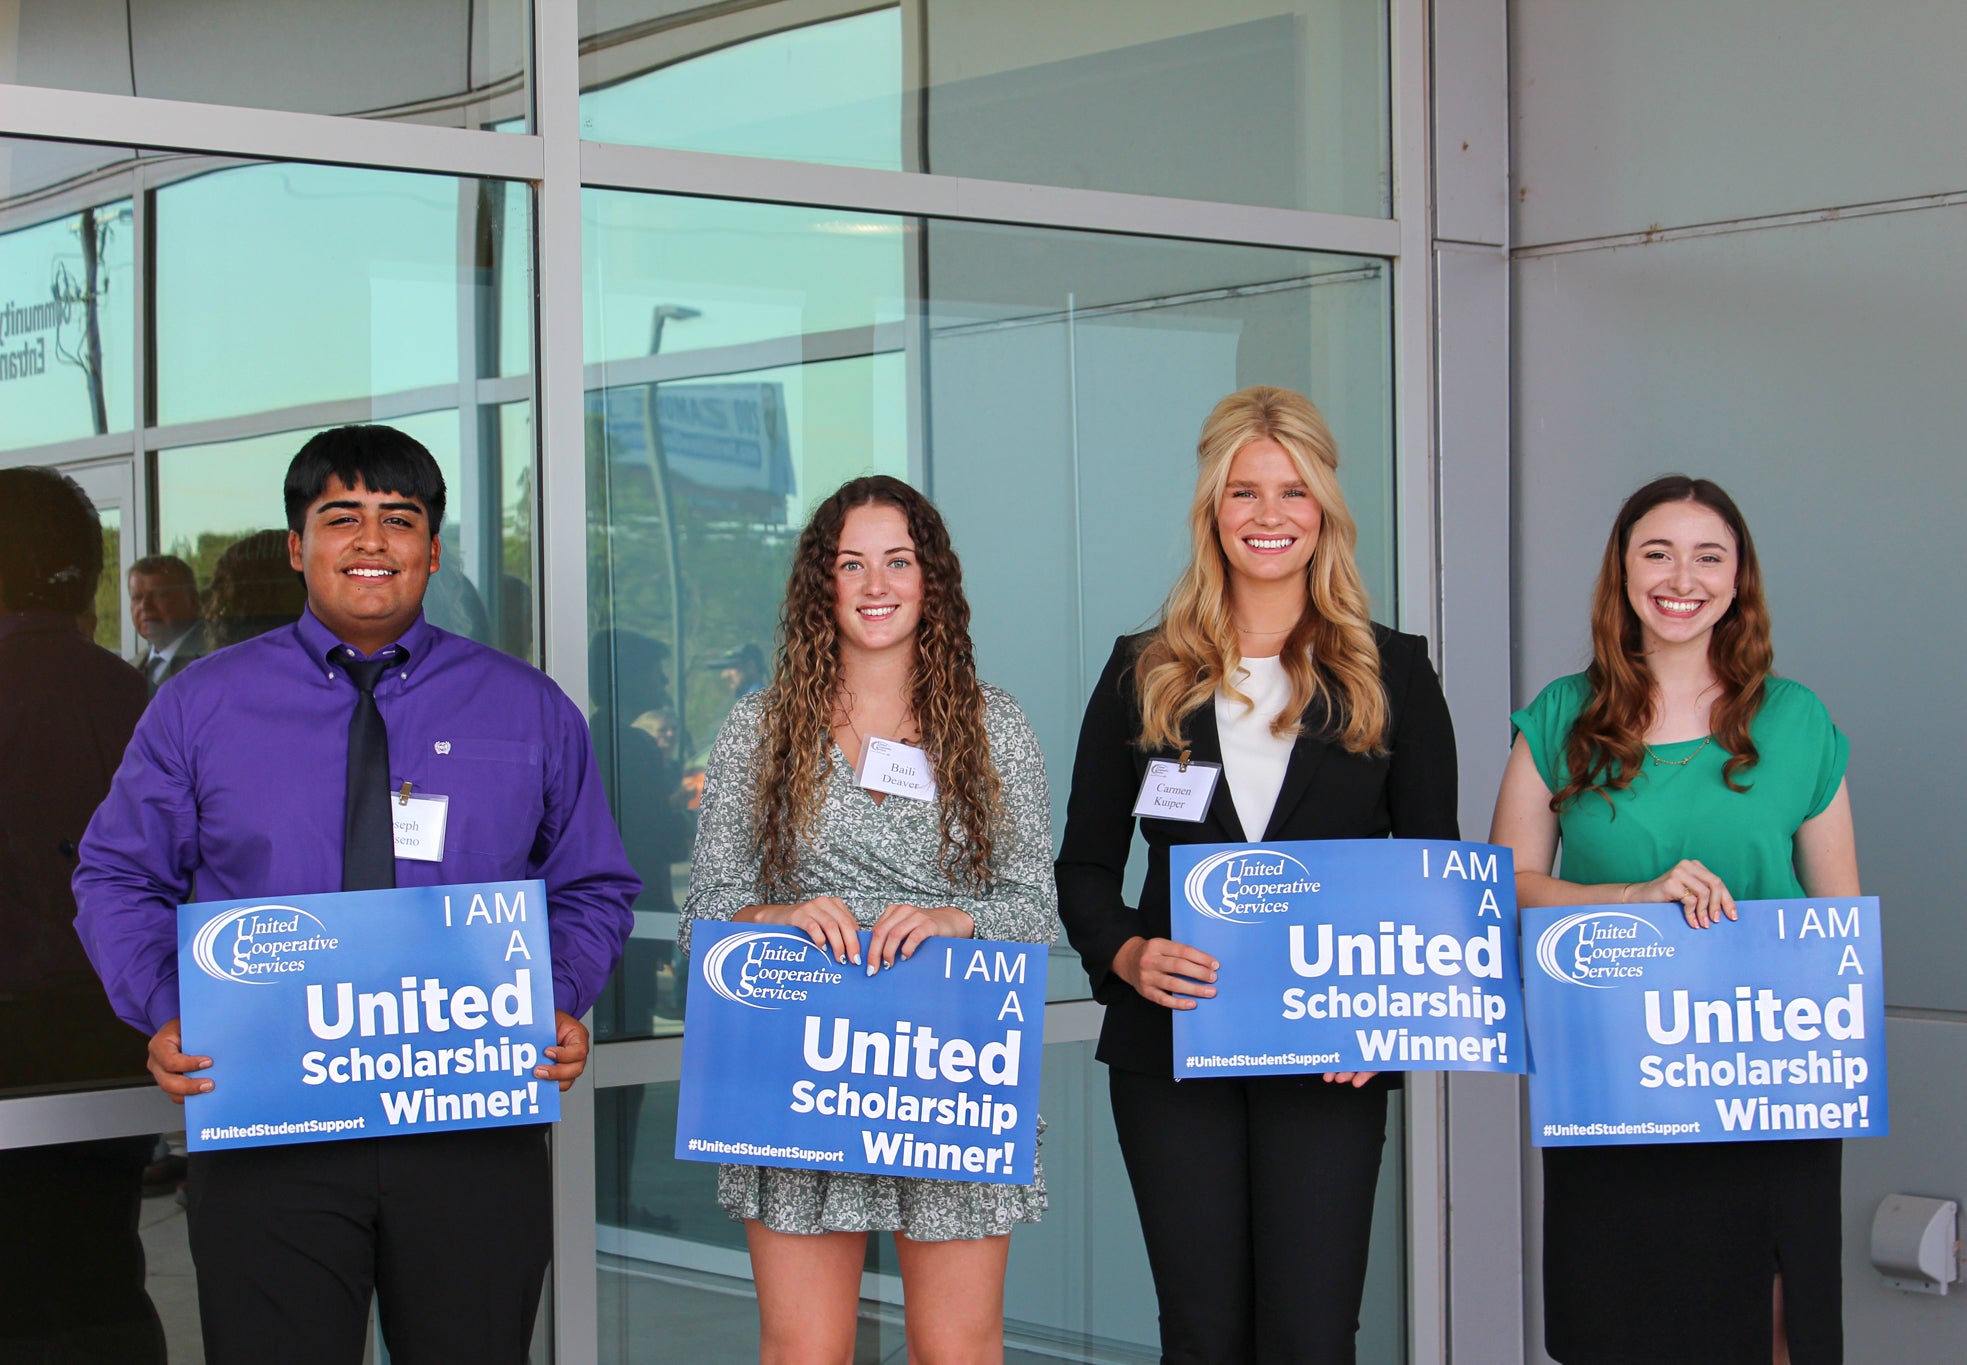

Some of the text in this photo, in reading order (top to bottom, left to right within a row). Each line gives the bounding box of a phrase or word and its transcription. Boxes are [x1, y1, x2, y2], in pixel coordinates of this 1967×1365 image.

[882, 775, 919, 789] Deaver
[891, 763, 916, 776] Baili
[1157, 783, 1191, 795] Carmen
[1154, 797, 1185, 809] Kuiper
[393, 821, 419, 833] seph
[395, 836, 420, 847] seno
[1226, 859, 1284, 881] United
[1422, 849, 1498, 882] I AM
[1222, 878, 1321, 898] Cooperative
[445, 891, 526, 927] I AM
[1219, 896, 1288, 916] Services
[1478, 889, 1502, 919] A
[236, 916, 298, 938] United
[1578, 921, 1638, 946] United
[1778, 907, 1860, 939] I AM
[233, 936, 339, 956] Cooperative
[504, 930, 531, 962] A
[747, 942, 808, 964] United
[1289, 921, 1503, 979] United
[1574, 941, 1675, 962] Cooperative
[230, 952, 305, 976] Services
[741, 960, 842, 984] Cooperative
[944, 948, 1026, 984] I AM
[1572, 958, 1643, 979] Services
[1838, 945, 1864, 976] A
[736, 976, 807, 1001] Services
[306, 969, 533, 1040] United
[998, 991, 1024, 1022] A
[1282, 986, 1506, 1025] Scholarship
[1644, 984, 1865, 1045] United
[802, 1016, 1022, 1086] United
[1356, 1029, 1508, 1064] Winner!
[302, 1037, 537, 1086] Scholarship
[1186, 1052, 1340, 1068] #UnitedStudentSupport
[1639, 1050, 1868, 1089] Scholarship
[380, 1082, 540, 1126] Winner!
[790, 1081, 1018, 1135] Scholarship
[1716, 1096, 1869, 1131] Winner!
[201, 1116, 365, 1141] #UnitedStudentSupport
[1543, 1121, 1700, 1136] #UnitedStudentSupport
[688, 1139, 844, 1162] #UnitedStudentSupport
[862, 1130, 1015, 1175] Winner!
